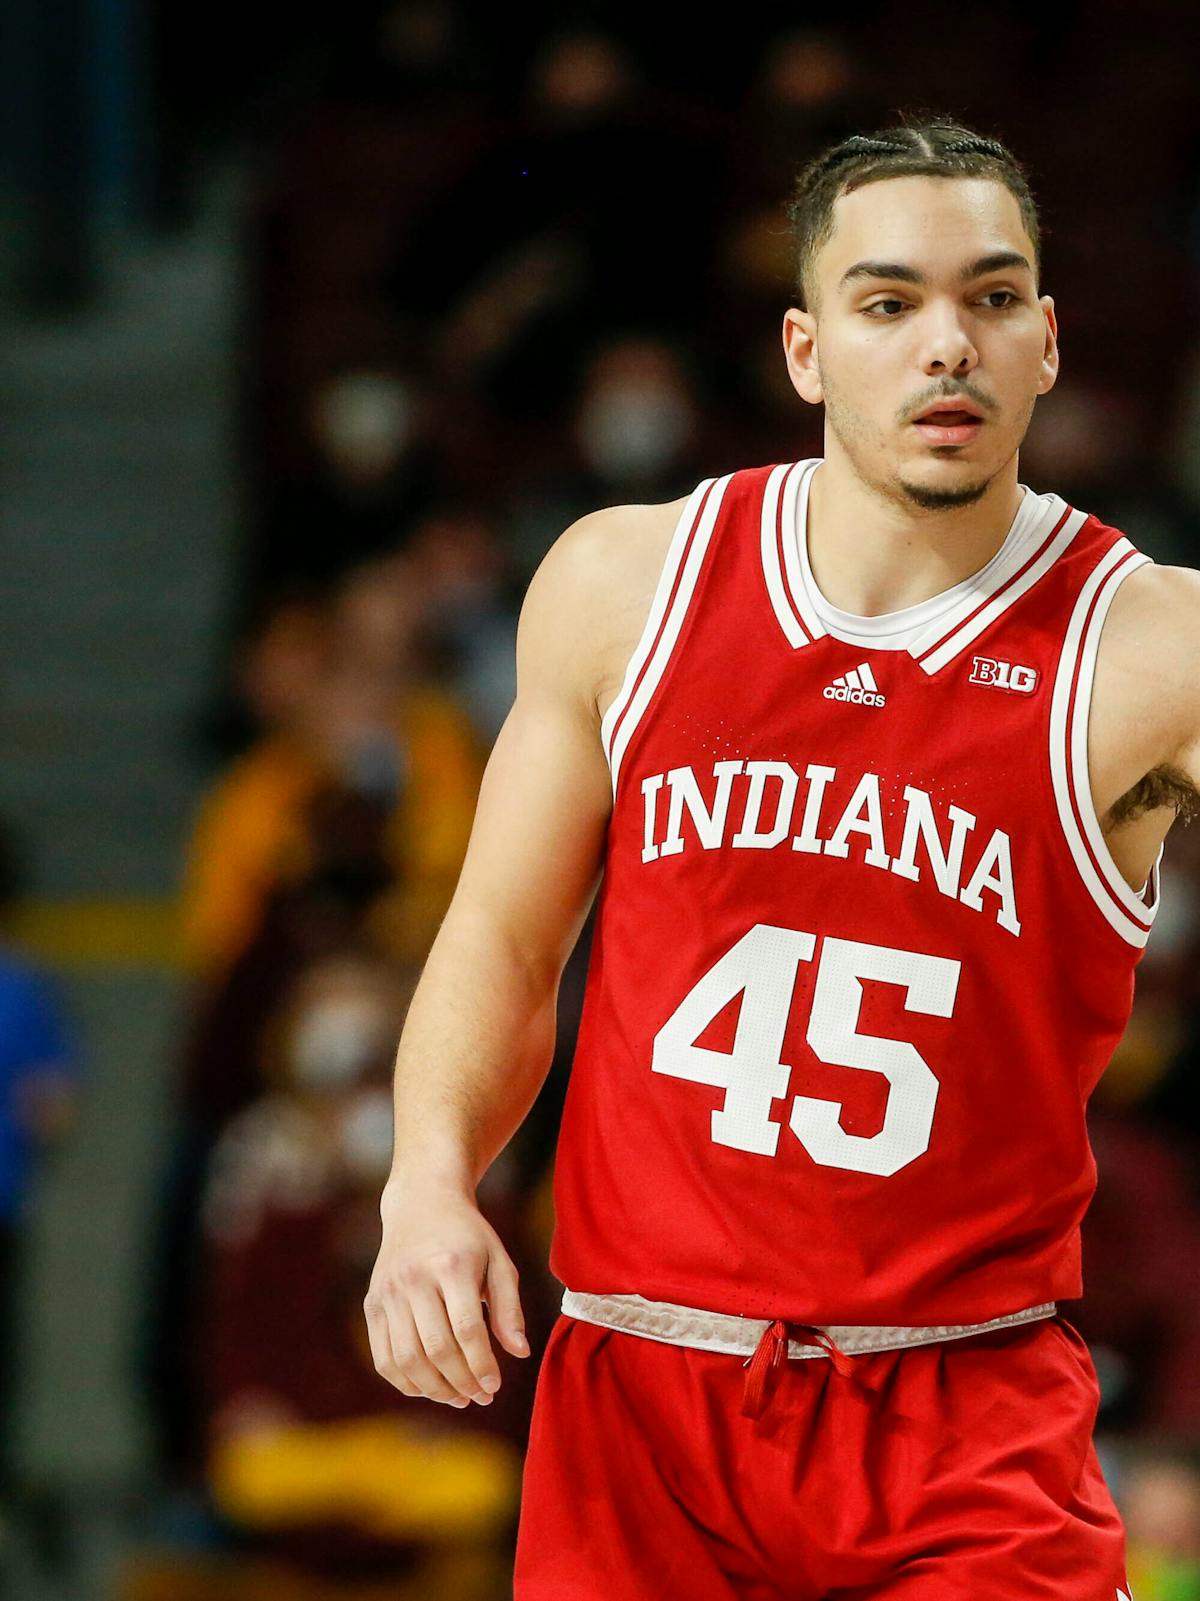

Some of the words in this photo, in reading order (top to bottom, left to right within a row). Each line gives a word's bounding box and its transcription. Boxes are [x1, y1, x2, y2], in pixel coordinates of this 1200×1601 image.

[822, 683, 886, 708] adidas
[641, 759, 1023, 938] INDIANA
[650, 922, 962, 1178] 45
